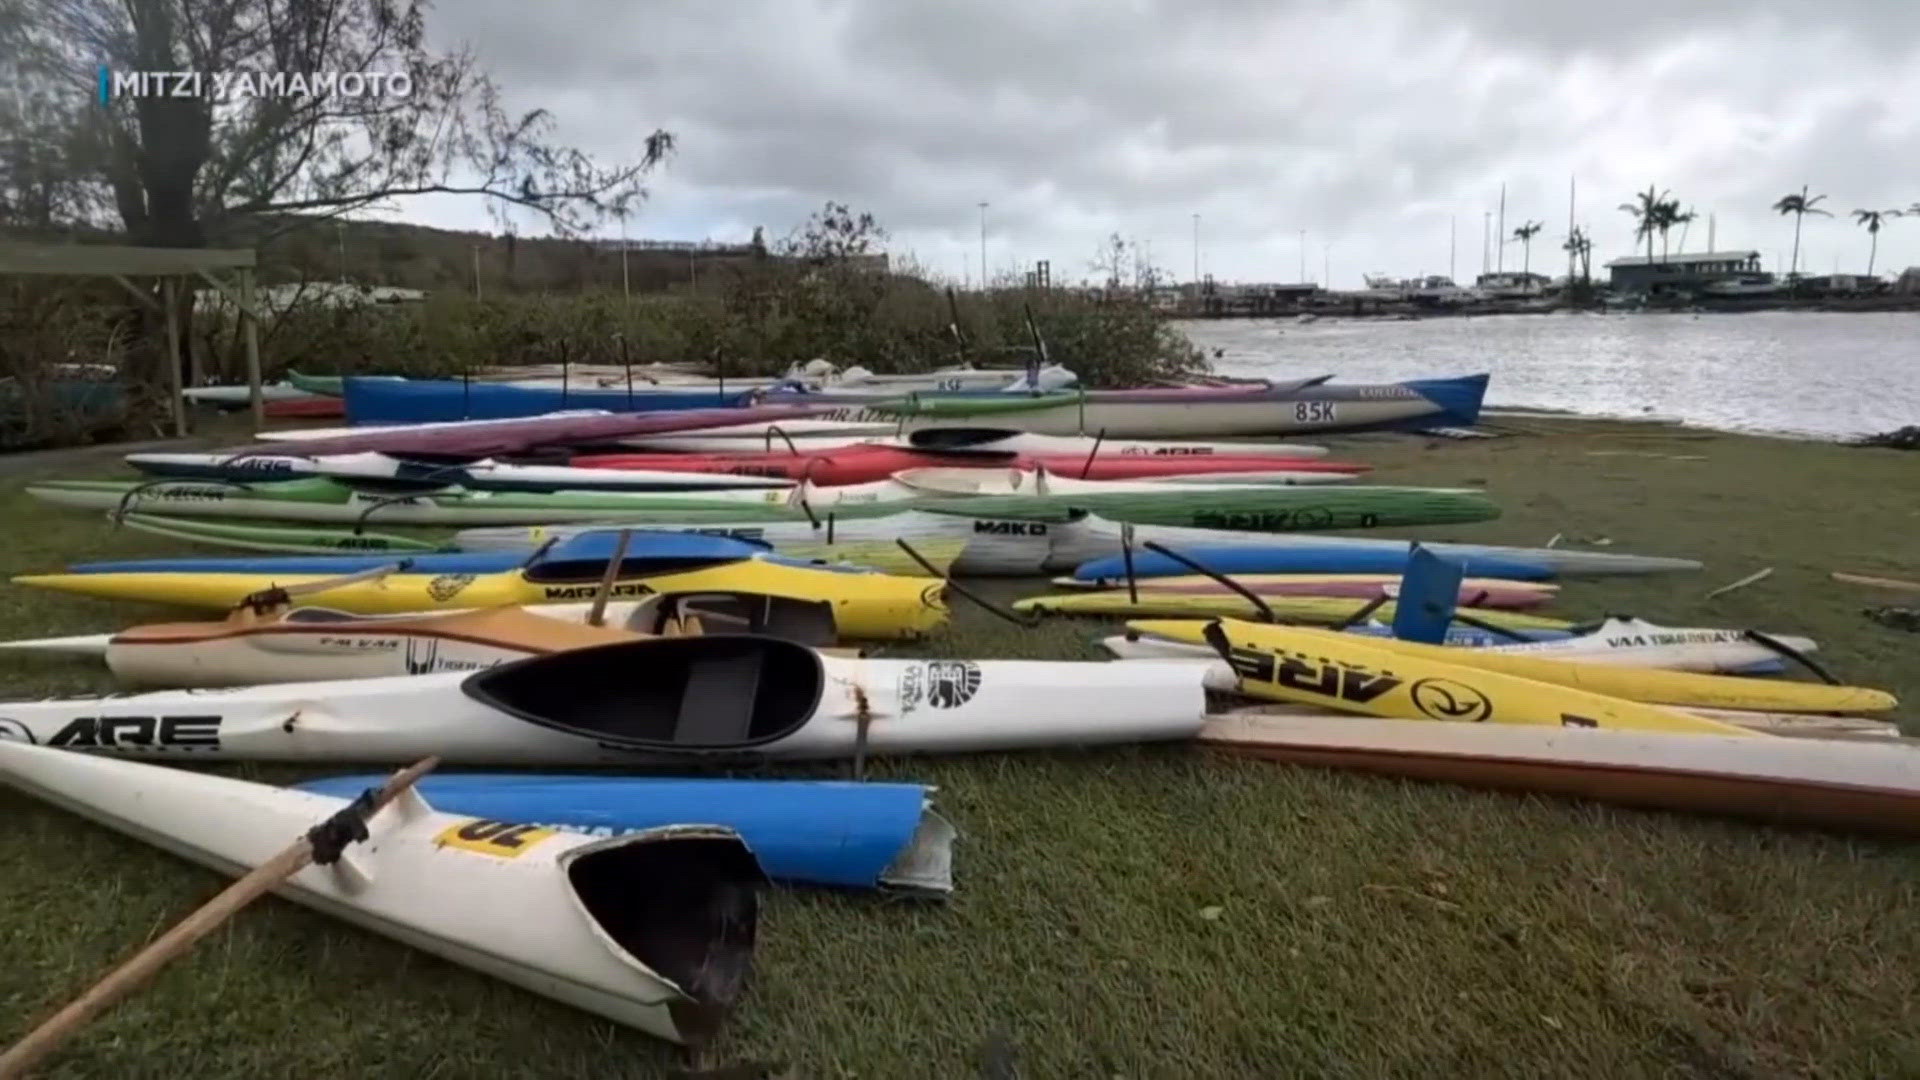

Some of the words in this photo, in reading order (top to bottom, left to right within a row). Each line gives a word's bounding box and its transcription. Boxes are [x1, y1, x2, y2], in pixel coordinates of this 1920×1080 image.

[1295, 402, 1335, 421] 85K
[974, 521, 1047, 536] MAKO
[544, 584, 657, 599] MARRA
